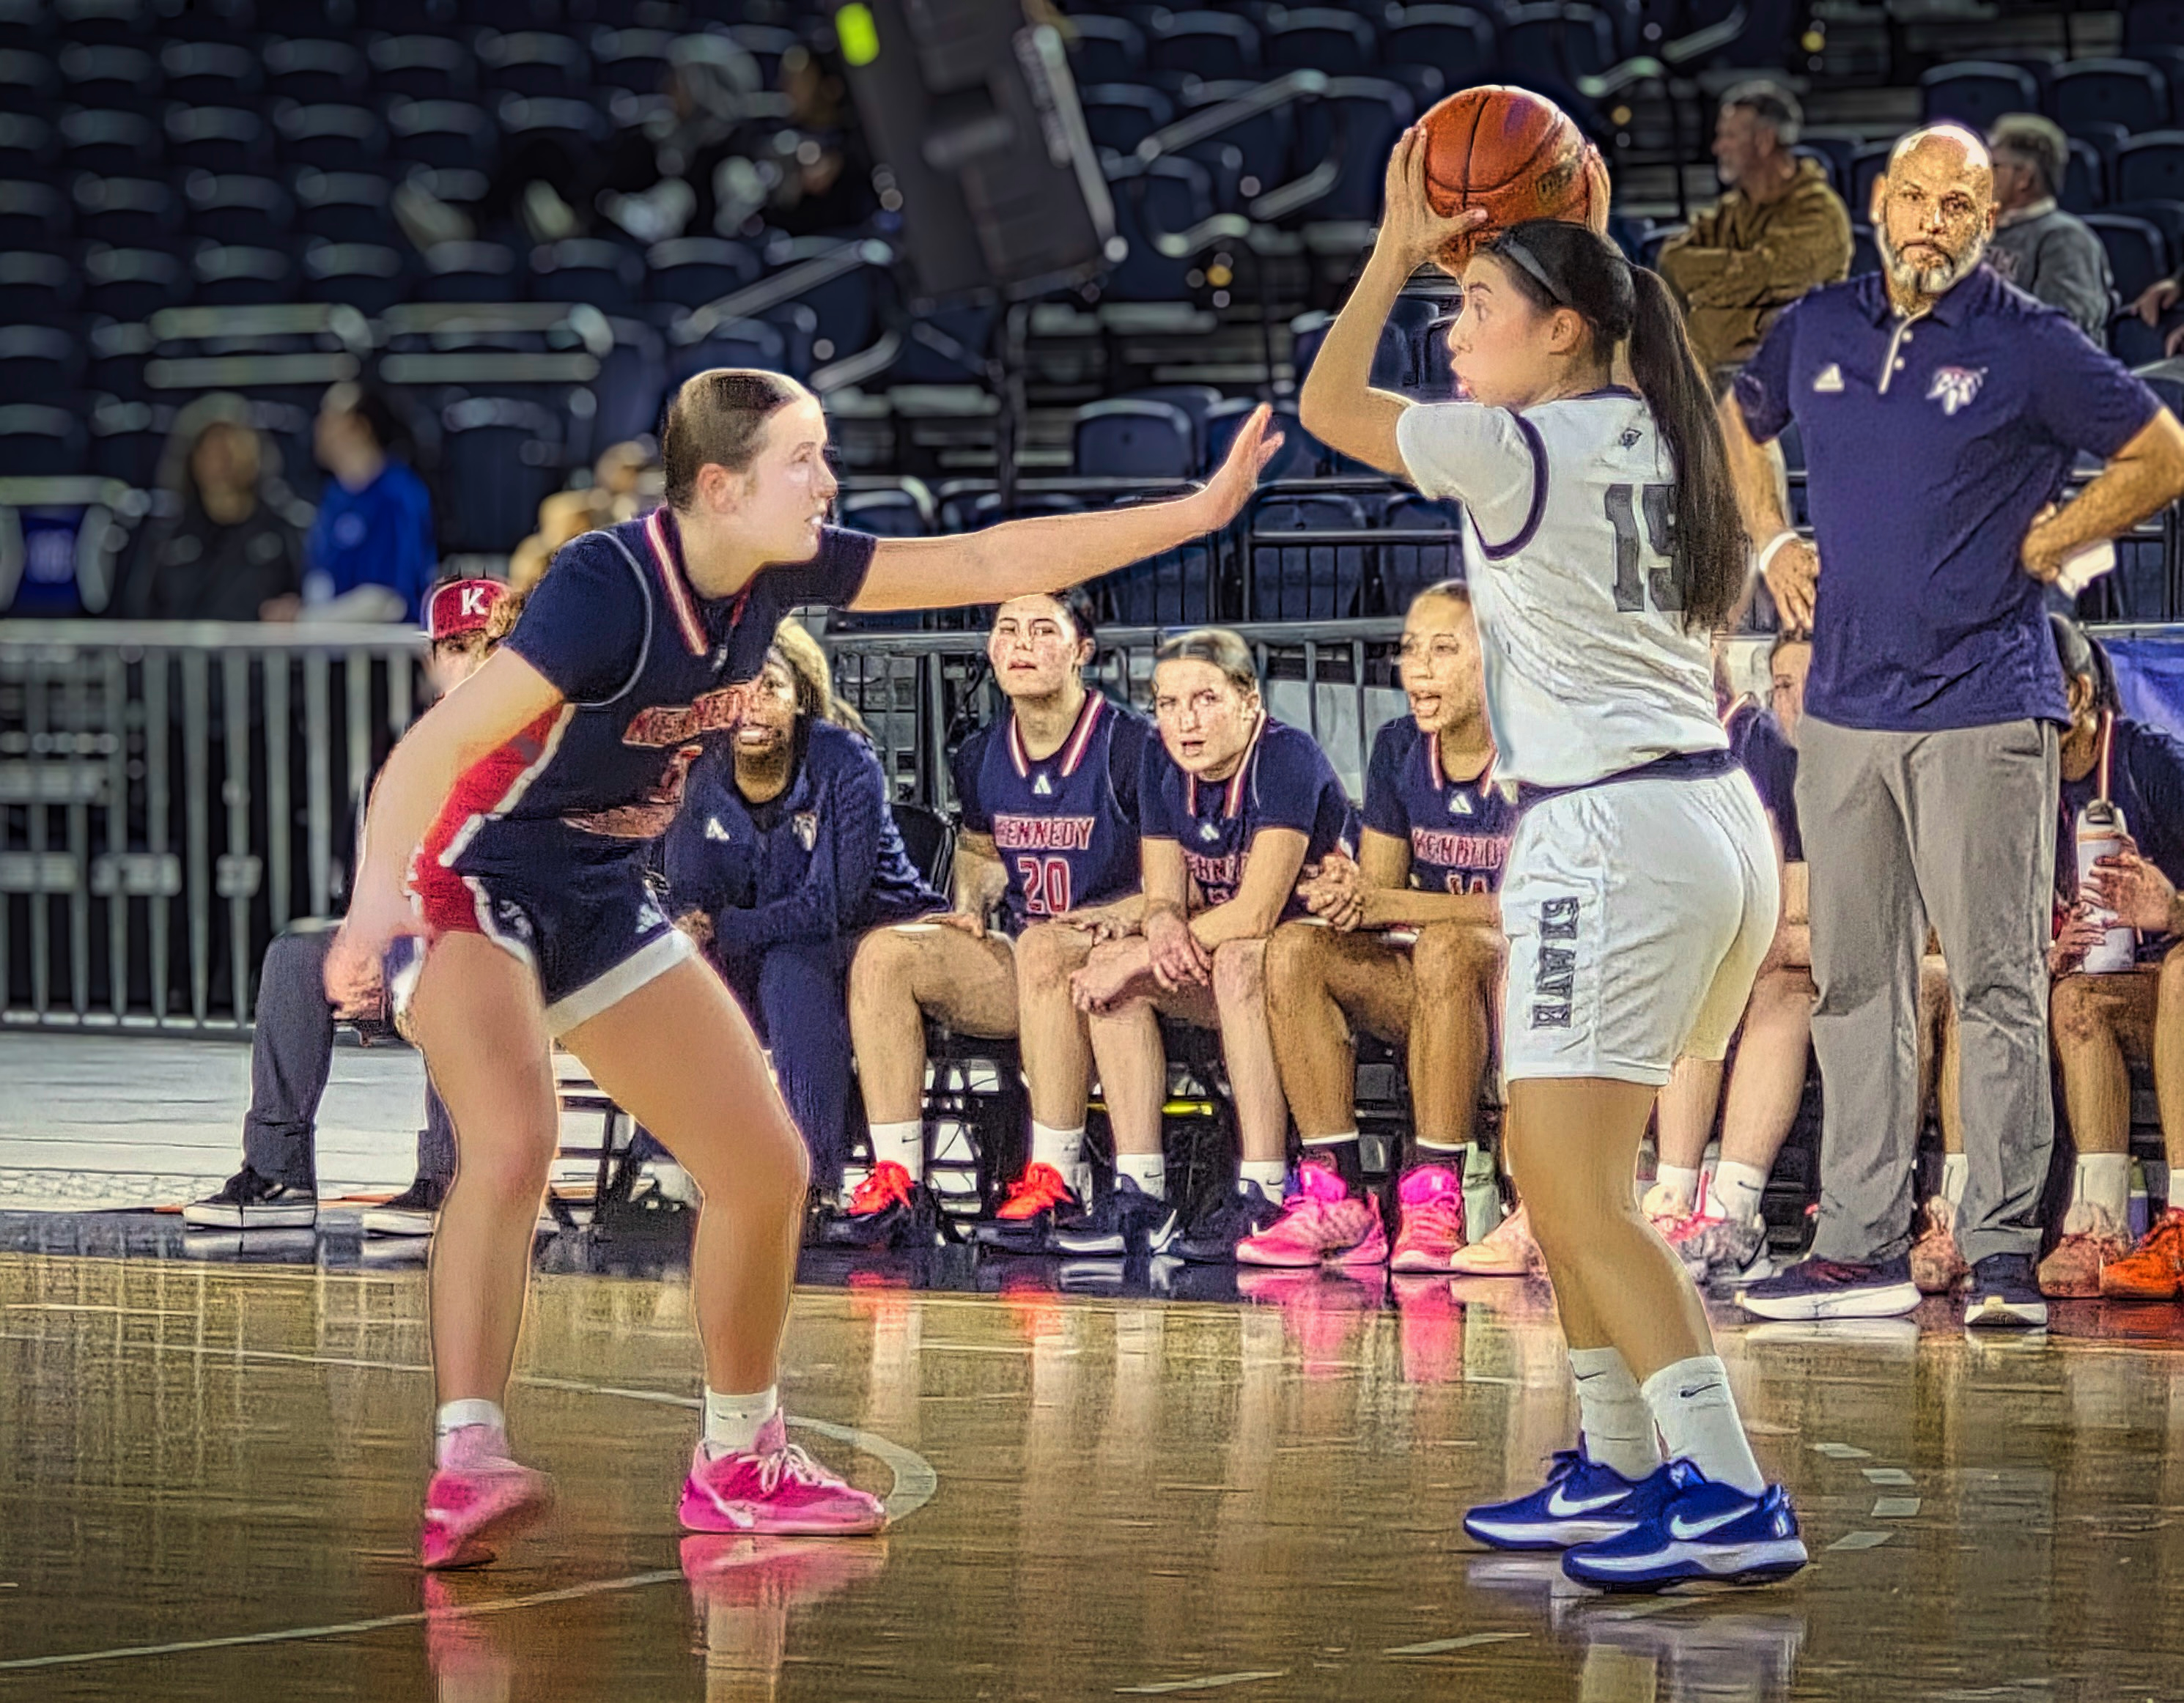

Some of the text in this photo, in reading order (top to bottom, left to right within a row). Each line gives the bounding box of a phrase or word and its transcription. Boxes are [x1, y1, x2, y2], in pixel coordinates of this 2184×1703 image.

[462, 588, 485, 616] K
[994, 815, 1095, 850] KENNEDY
[1017, 856, 1070, 915] 20
